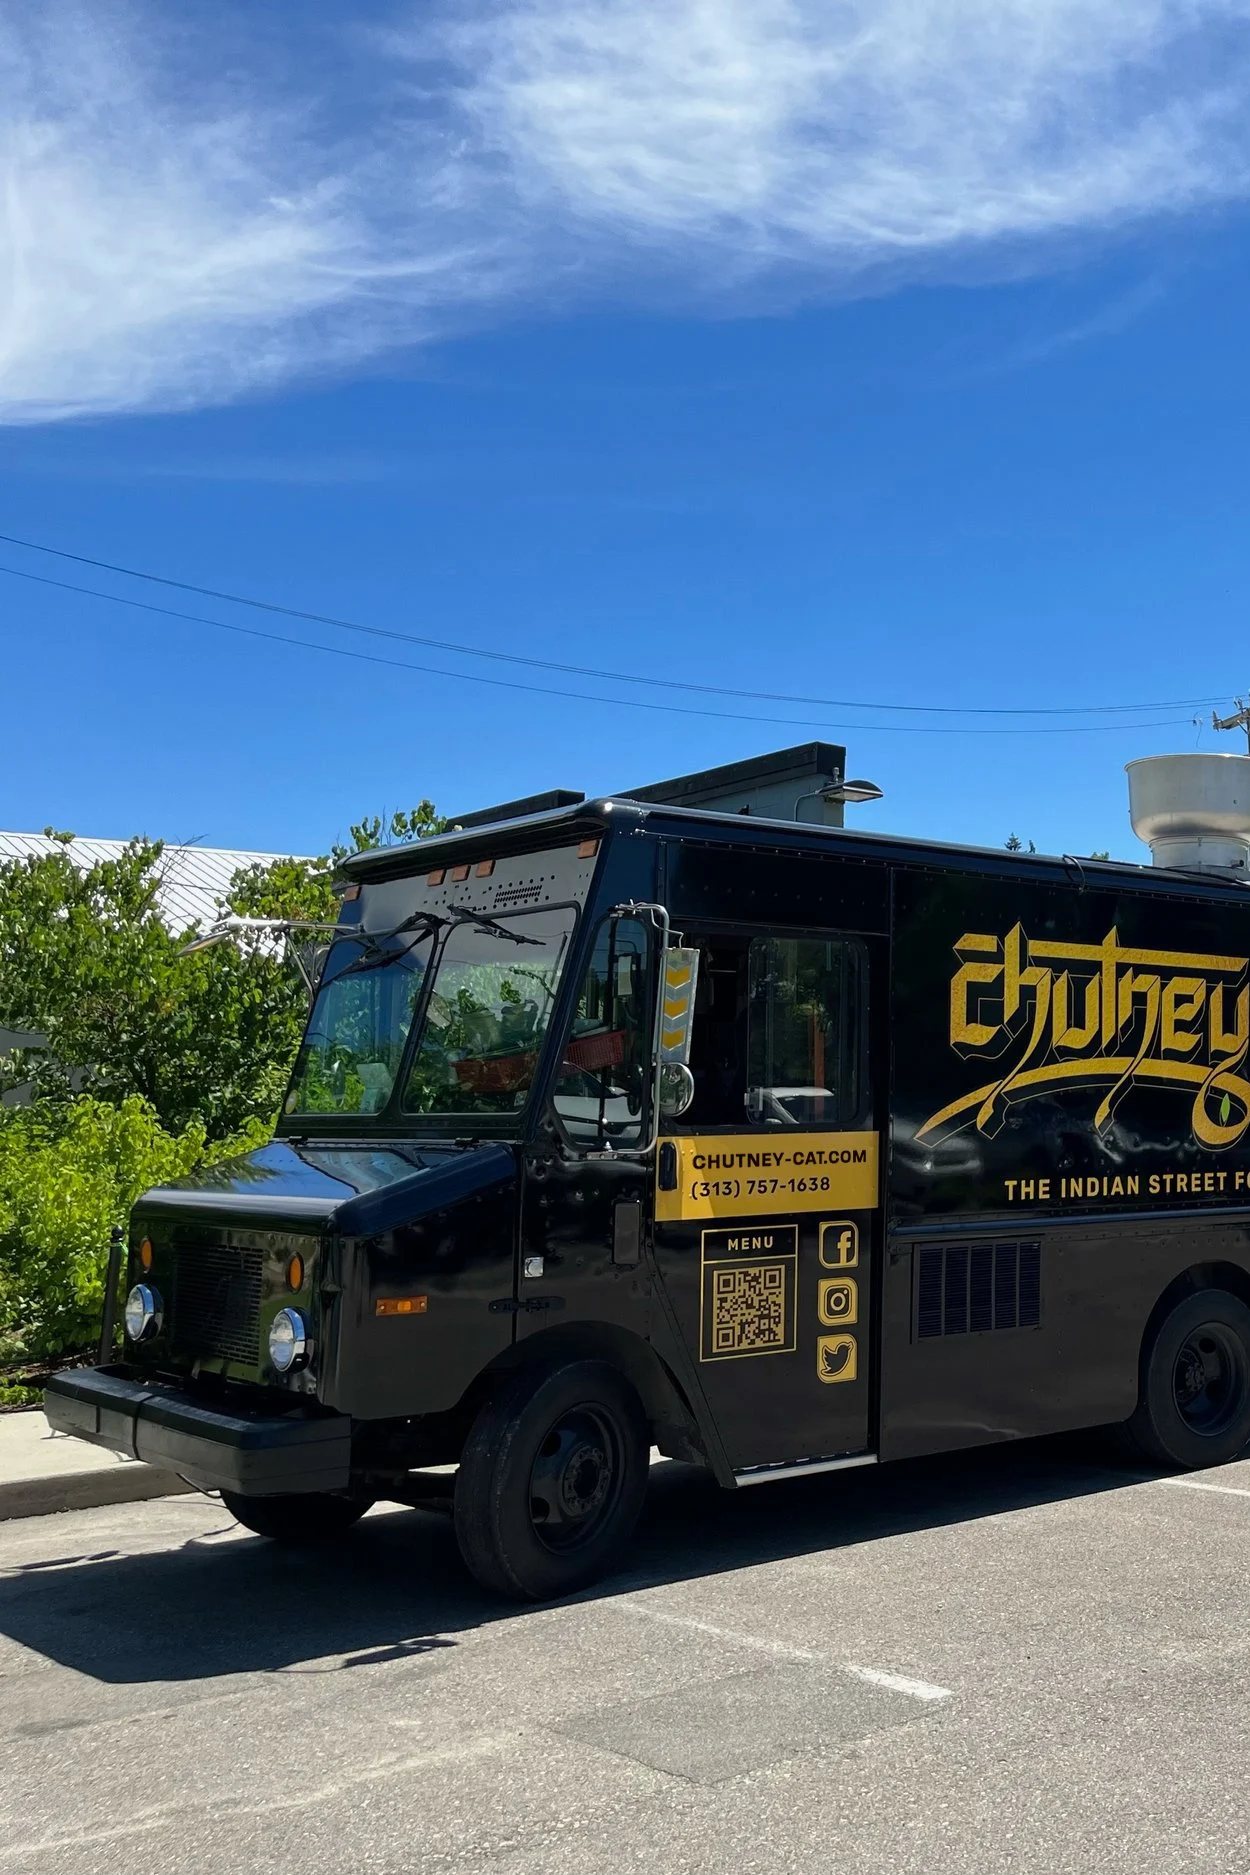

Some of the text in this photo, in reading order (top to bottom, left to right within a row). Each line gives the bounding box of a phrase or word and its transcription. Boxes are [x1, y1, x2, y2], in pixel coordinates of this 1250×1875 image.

[692, 1149, 867, 1170] CHUTNEY-CAT.COM
[691, 1176, 831, 1200] (313) 757-1638
[1004, 1179, 1051, 1201] THE
[1061, 1175, 1140, 1199] INDIAN
[1148, 1171, 1227, 1194] STREET
[727, 1235, 775, 1251] MENU
